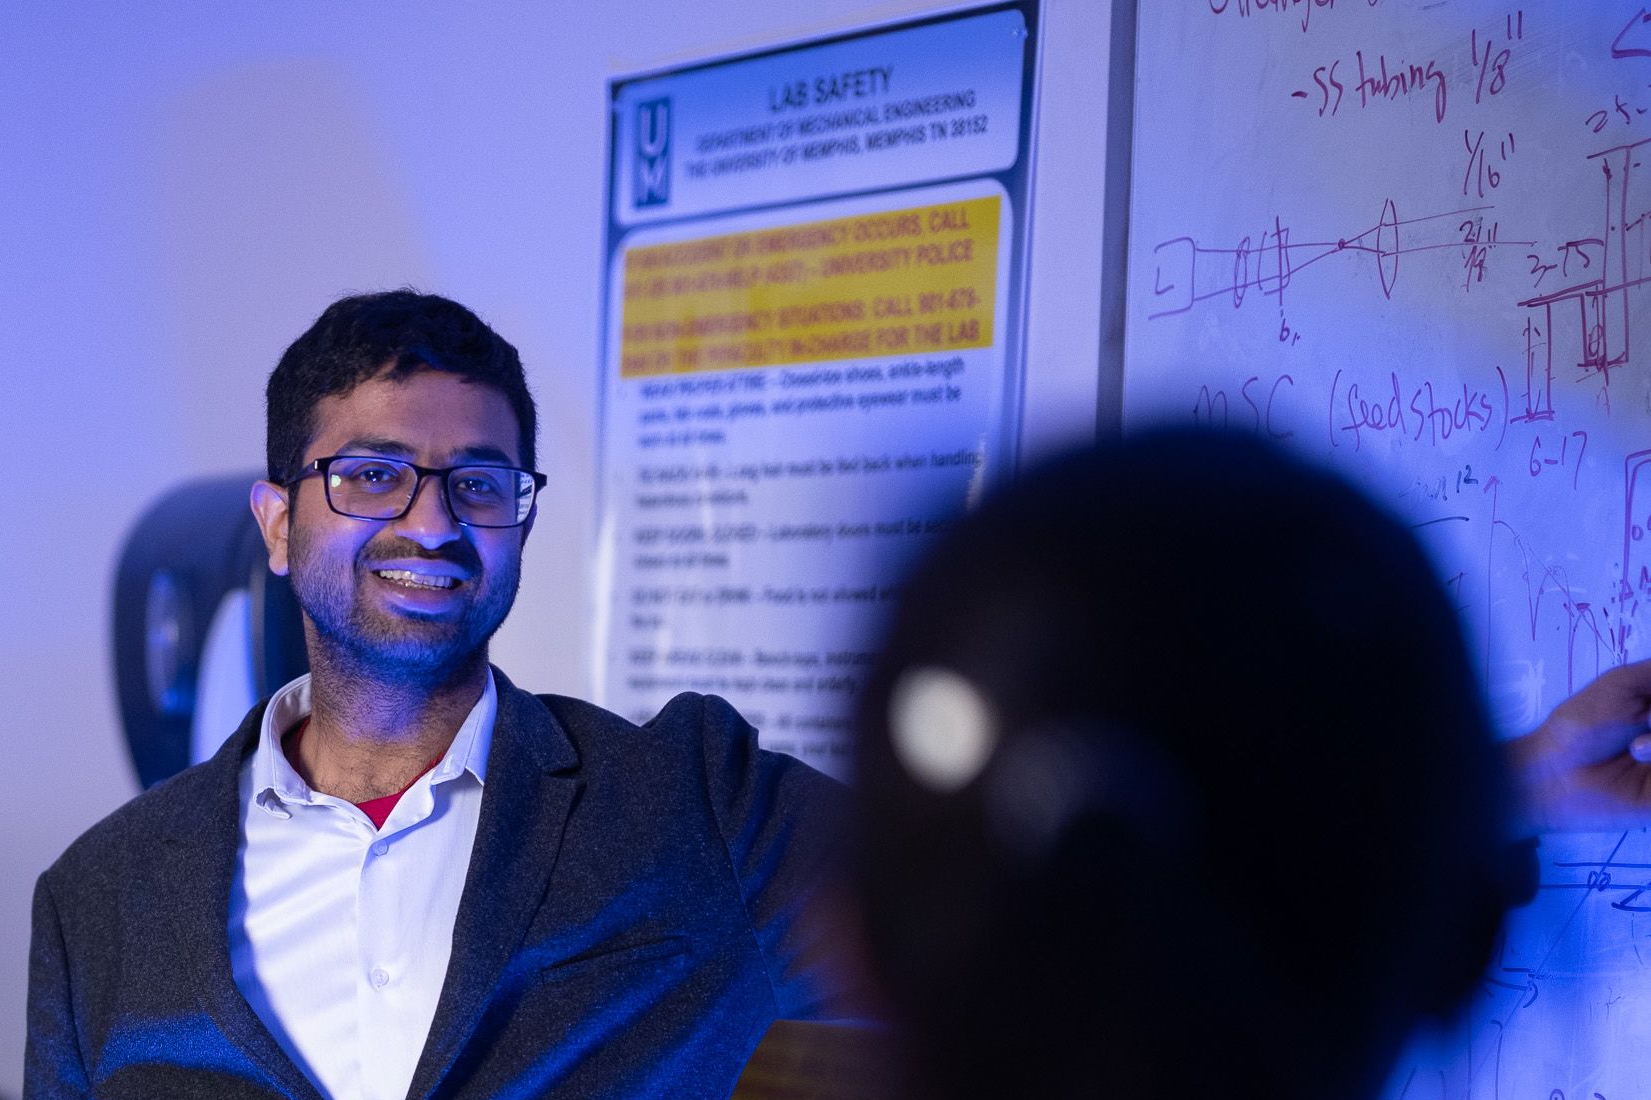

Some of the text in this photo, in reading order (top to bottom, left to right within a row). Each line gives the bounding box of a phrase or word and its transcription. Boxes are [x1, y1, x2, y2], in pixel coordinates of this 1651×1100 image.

[769, 65, 894, 113] LAB SAFETY
[1355, 51, 1447, 124] tubing
[778, 119, 796, 139] OF
[799, 106, 880, 134] MECHANICAL
[883, 90, 976, 121] ENGINEERING
[865, 124, 927, 151] MEMPHIS
[929, 121, 950, 141] TN
[928, 207, 970, 233] CALL
[914, 238, 974, 265] POLICE
[872, 296, 913, 318] CALL
[915, 323, 943, 346] THE
[949, 319, 980, 343] LAB
[930, 445, 983, 470] handling
